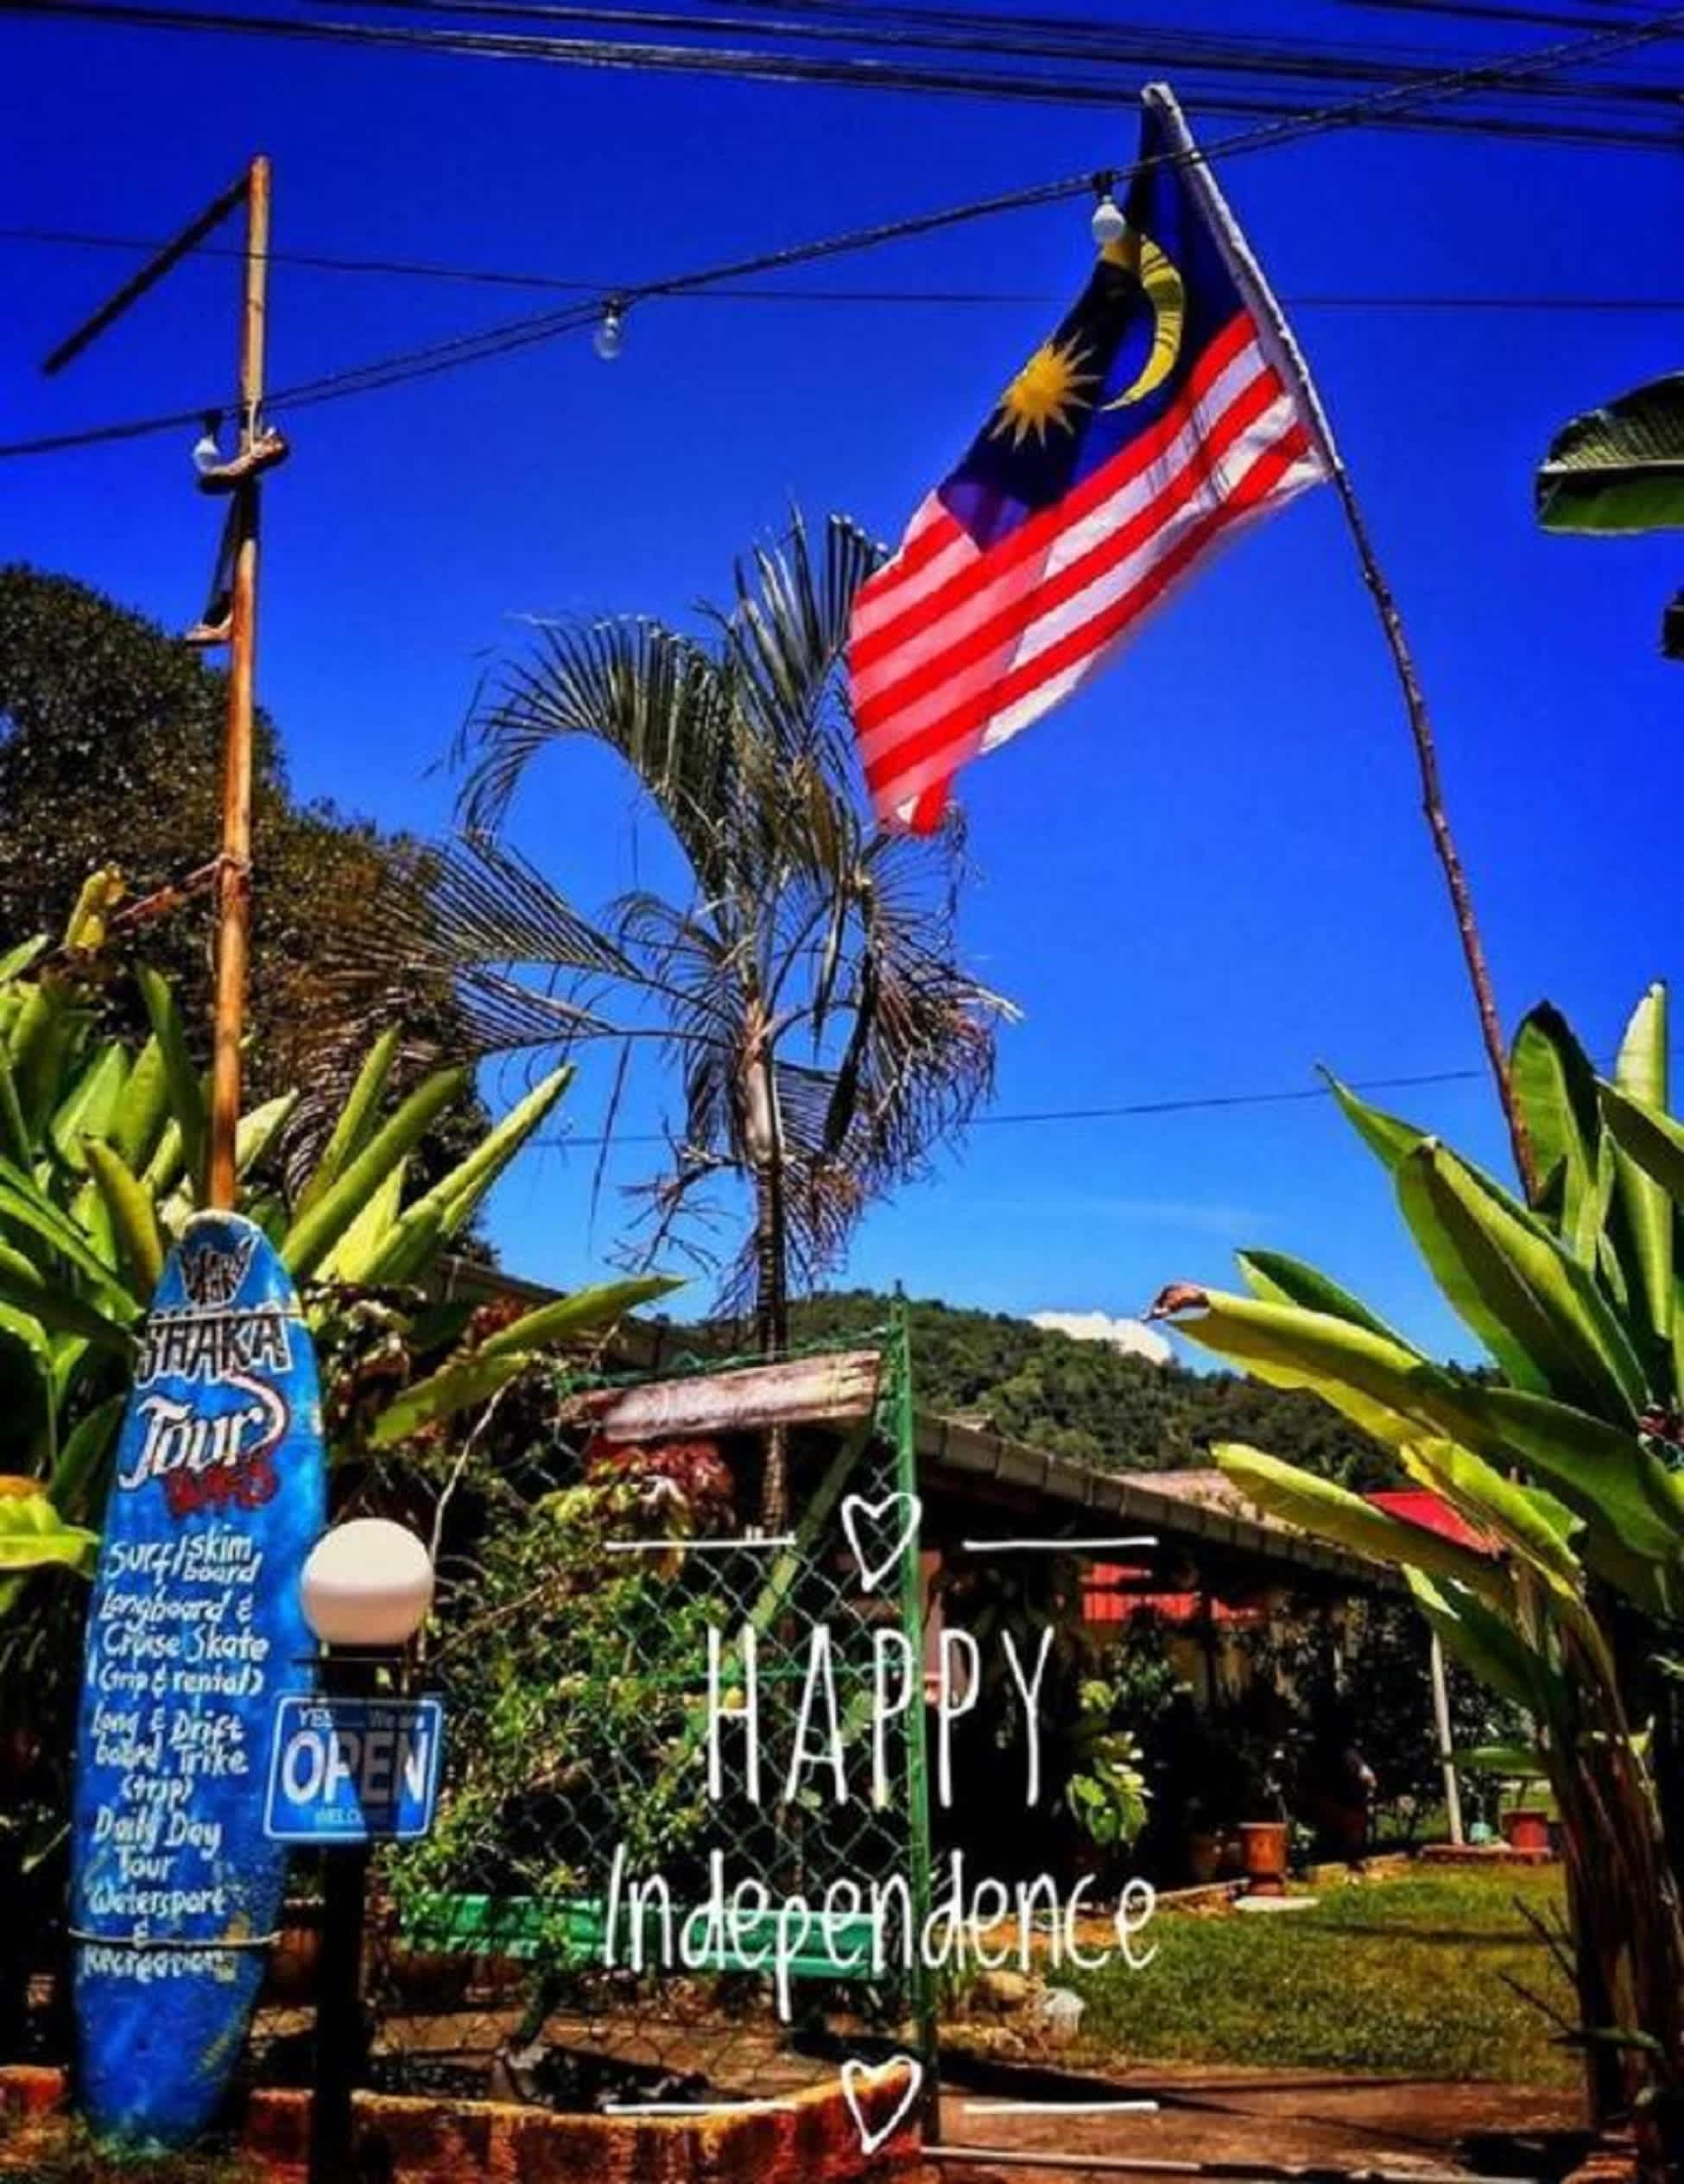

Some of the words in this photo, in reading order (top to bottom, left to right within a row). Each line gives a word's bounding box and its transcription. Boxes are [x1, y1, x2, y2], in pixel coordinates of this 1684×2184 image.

[282, 1729, 429, 1804] OPEN
[163, 1811, 222, 1860] Day
[114, 1844, 176, 1883] Tour
